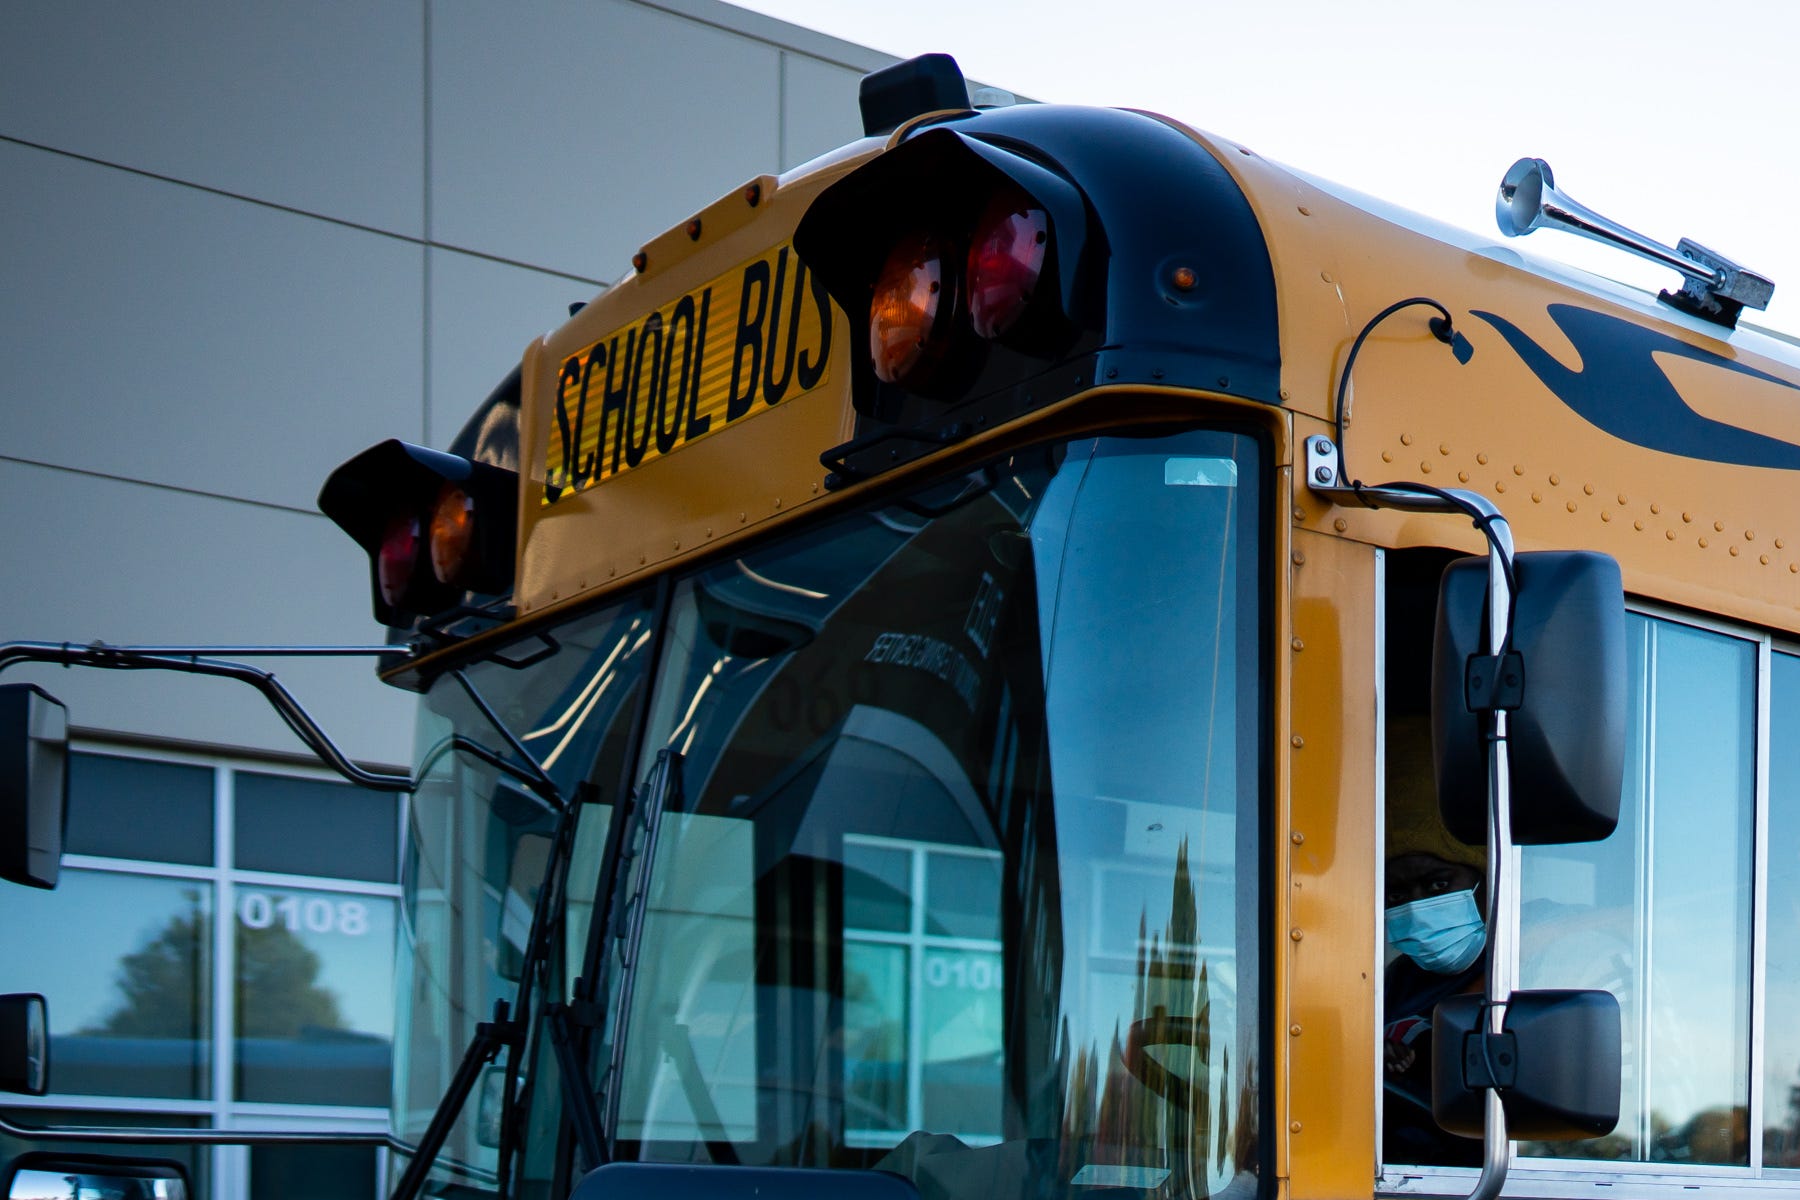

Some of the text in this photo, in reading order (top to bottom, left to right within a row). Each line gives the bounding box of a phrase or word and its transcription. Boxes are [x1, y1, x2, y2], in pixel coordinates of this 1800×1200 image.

[546, 246, 832, 503] SCHOOL BUS
[239, 892, 368, 936] 0108
[925, 957, 1002, 991] 010
